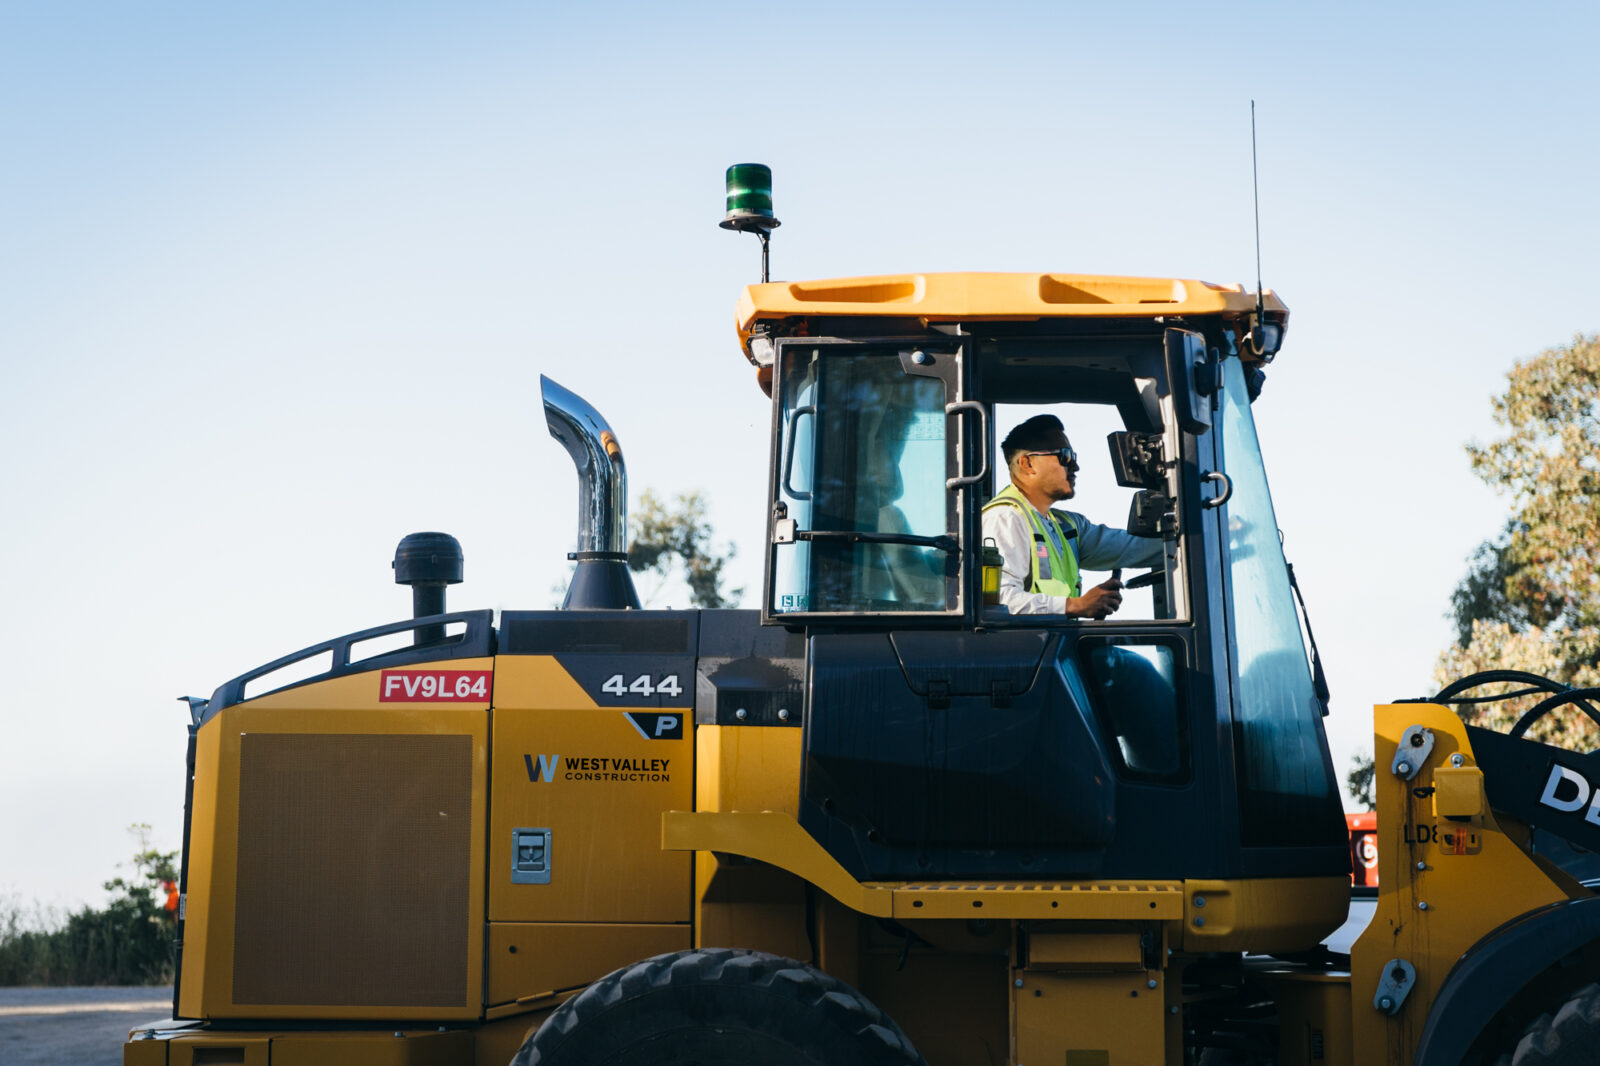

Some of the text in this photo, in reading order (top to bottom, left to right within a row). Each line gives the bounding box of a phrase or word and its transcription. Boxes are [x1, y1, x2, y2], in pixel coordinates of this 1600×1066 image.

[384, 675, 487, 698] FV9L64
[601, 674, 683, 697] 444
[654, 715, 678, 736] P
[565, 757, 671, 772] WEST VALLEY
[564, 772, 671, 782] CONSTRUCTION
